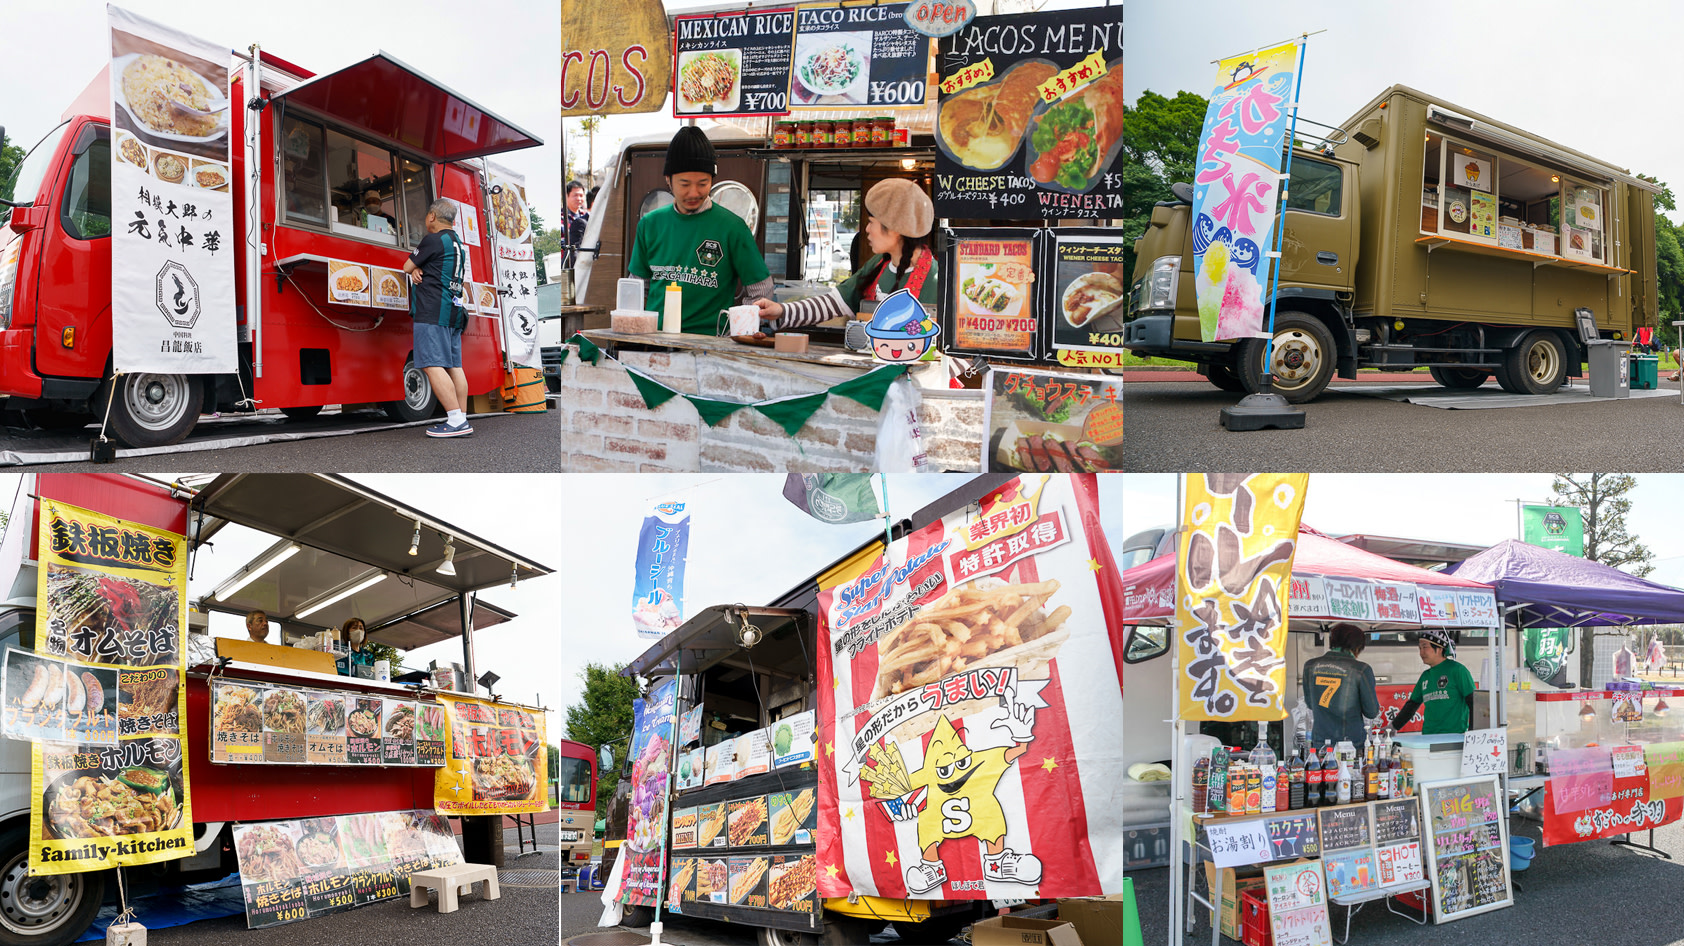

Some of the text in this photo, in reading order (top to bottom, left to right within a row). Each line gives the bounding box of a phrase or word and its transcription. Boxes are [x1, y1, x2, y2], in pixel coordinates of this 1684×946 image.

[799, 9, 845, 25] TACO
[848, 6, 888, 23] RICE
[680, 14, 792, 40] MEXICAN RICE
[679, 41, 728, 50] メキシカンライス
[948, 24, 1037, 56] TACOS
[561, 44, 648, 110] COS
[943, 62, 992, 93] おすすめ!
[1044, 59, 1102, 101] おすすめ!
[744, 92, 787, 111] ¥700
[870, 80, 925, 104] ¥600
[937, 172, 1037, 192] W CHEESE TACOS
[989, 192, 1026, 209] ¥400
[1037, 192, 1106, 210] WIENER
[128, 211, 221, 256] 元気中華
[960, 243, 1028, 257] STANDARD TACOS
[966, 318, 995, 331] ¥400
[1006, 318, 1036, 332] ¥700
[161, 340, 202, 354] 昌龍飯店
[1004, 372, 1117, 405] ダチョウステーキ
[968, 501, 1033, 542] 業界初
[51, 517, 176, 568] 鉄板焼き
[959, 521, 1058, 576] 特許取得
[647, 525, 673, 606] ブルーシール
[835, 537, 952, 628] Star Potato
[836, 561, 890, 611] Super
[1326, 580, 1370, 598] ウーロンハイ
[1330, 599, 1370, 619] 緑茶割り
[1470, 608, 1495, 619] ジュース
[49, 618, 177, 658] 名物 オムそば
[848, 604, 922, 659] フライドポテト
[120, 669, 168, 685] こだわりの
[1315, 676, 1342, 709] 7
[5, 706, 115, 730] フランクフルト
[855, 696, 920, 753] 星の形だから
[920, 668, 1010, 710] うまい!
[119, 711, 178, 735] 焼きそば
[84, 728, 115, 742] 300円
[465, 729, 534, 758] ホルモン
[47, 738, 182, 771] 鉄板焼き ホルモン
[351, 743, 381, 753] ホルモン
[363, 757, 381, 765] ¥500
[1463, 753, 1490, 766] こちらへ
[1211, 773, 1225, 782] FIVE
[1211, 781, 1224, 790] STAR
[1210, 793, 1224, 802] 2017
[1441, 793, 1475, 817] BIG
[941, 796, 973, 834] S
[1334, 811, 1356, 819] Menu
[1386, 805, 1405, 813] Menu
[1209, 827, 1228, 836] 焼酎
[1269, 817, 1316, 837] カクテル
[675, 831, 694, 845] MENU
[1211, 833, 1267, 854] お湯割り
[40, 835, 187, 863] family-kitchen
[1302, 843, 1318, 854] ¥500
[1392, 843, 1418, 862] HOT
[395, 857, 430, 876] やきそば
[1396, 863, 1420, 873] コーヒー
[1404, 871, 1421, 881] ¥300
[256, 879, 291, 895] ホルモン
[308, 874, 350, 895] ホルモン
[351, 871, 395, 889] フランクフルト
[1271, 873, 1288, 882] MENU
[1303, 873, 1316, 893] 茶
[256, 886, 302, 909] 焼きそば
[329, 893, 353, 907] ¥500
[375, 886, 397, 899] ¥300
[1272, 892, 1296, 903] ウーロン茶
[276, 906, 305, 921] ¥600
[791, 899, 813, 913] 700円
